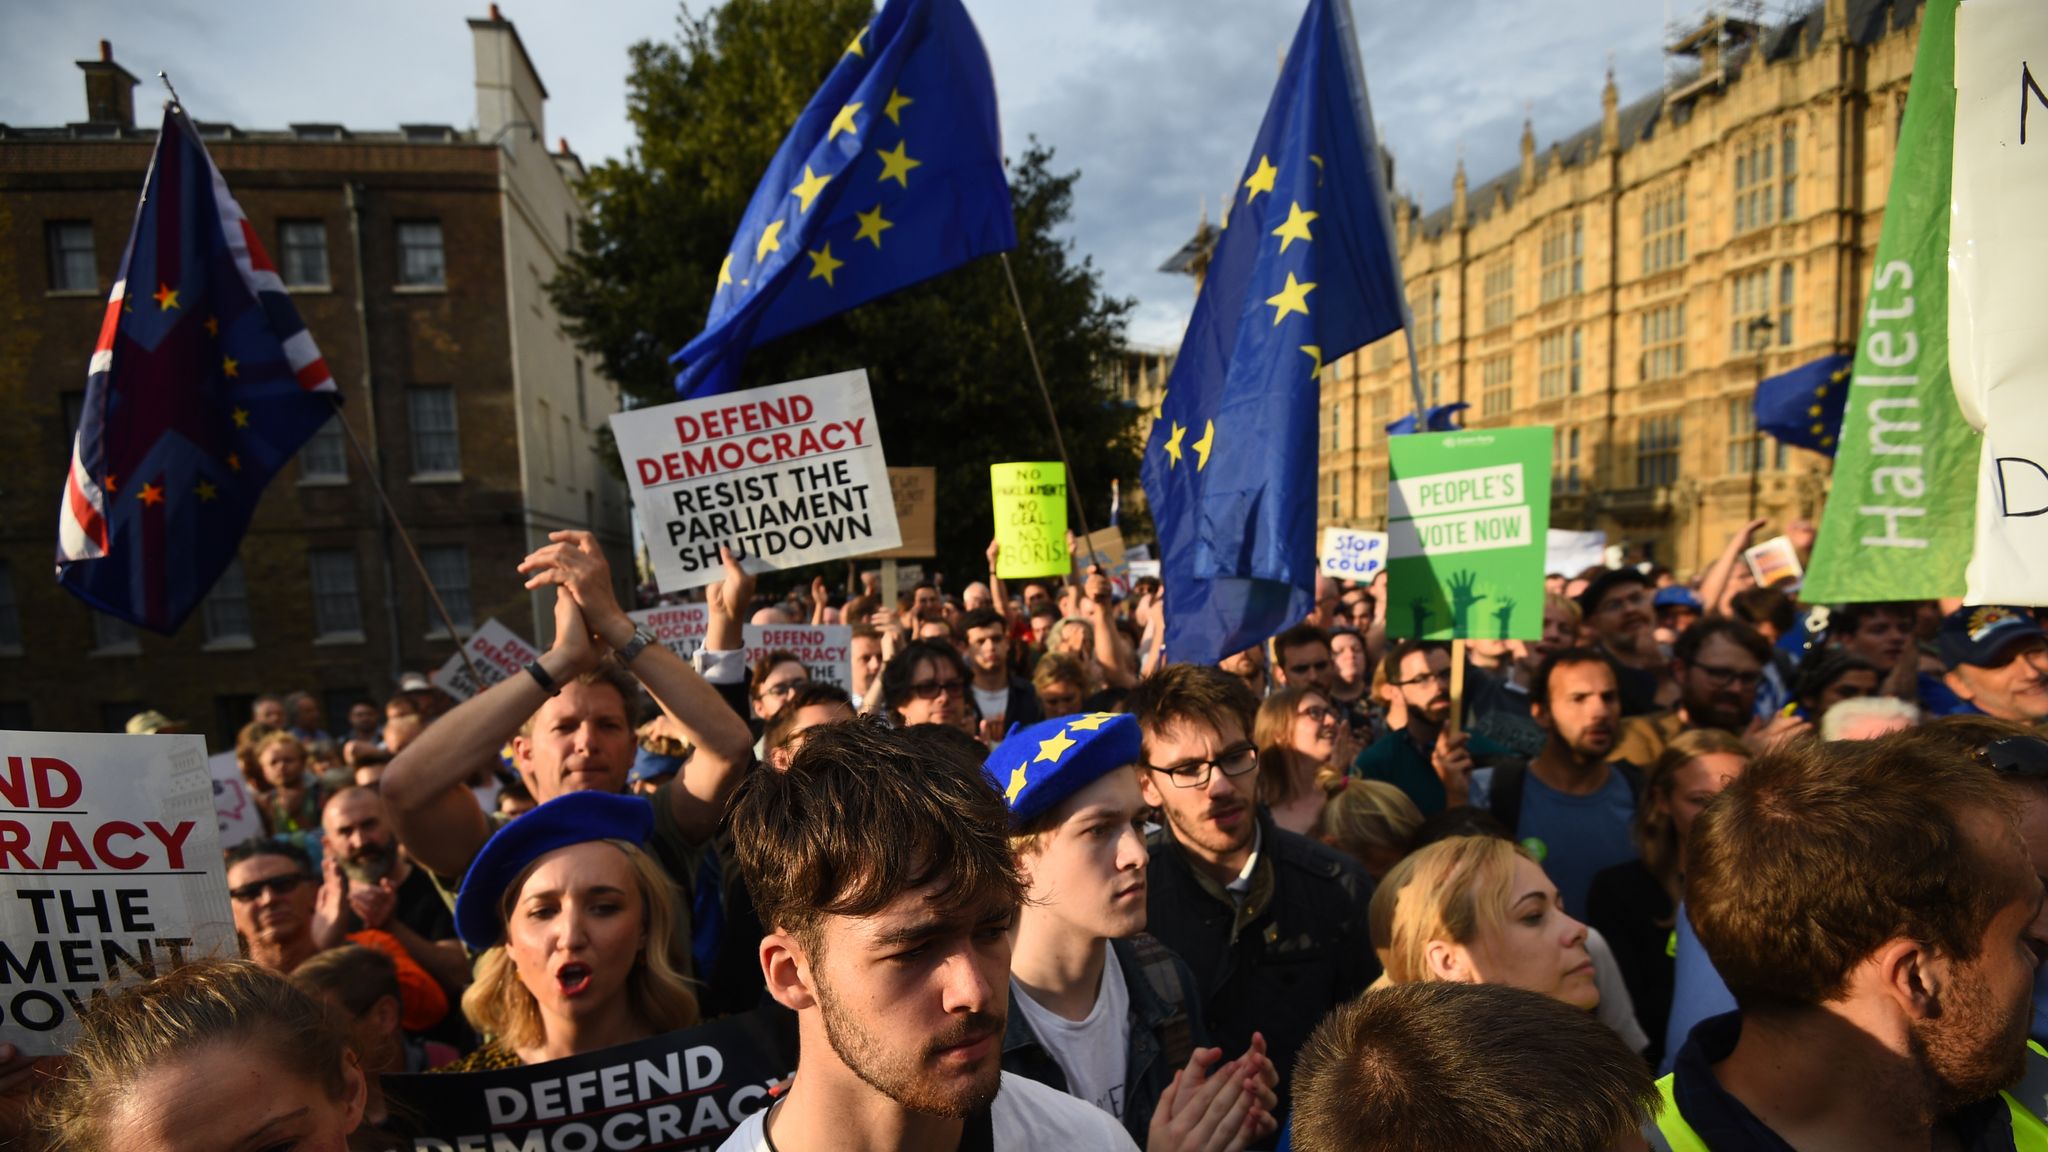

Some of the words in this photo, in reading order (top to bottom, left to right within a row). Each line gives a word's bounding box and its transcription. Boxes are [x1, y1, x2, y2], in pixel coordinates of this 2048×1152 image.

[675, 394, 814, 444] DEFEND
[1855, 259, 1929, 549] Hamlets
[636, 417, 867, 486] DEMOCRACY
[1017, 469, 1041, 480] NO
[673, 473, 779, 516] RESIST
[788, 459, 852, 492] THE
[1420, 473, 1515, 507] PEOPLE'S
[666, 485, 870, 547] PARLIAMENT
[1416, 521, 1467, 548] VOTE
[1474, 515, 1521, 542] NOW
[679, 513, 872, 573] SHUTDOWN
[1327, 557, 1378, 572] COUP
[1335, 535, 1379, 551] STOP
[647, 608, 703, 627] DEFEND
[762, 630, 825, 646] DEFEND
[17, 888, 155, 934] THE
[484, 1045, 724, 1125] DEFEND
